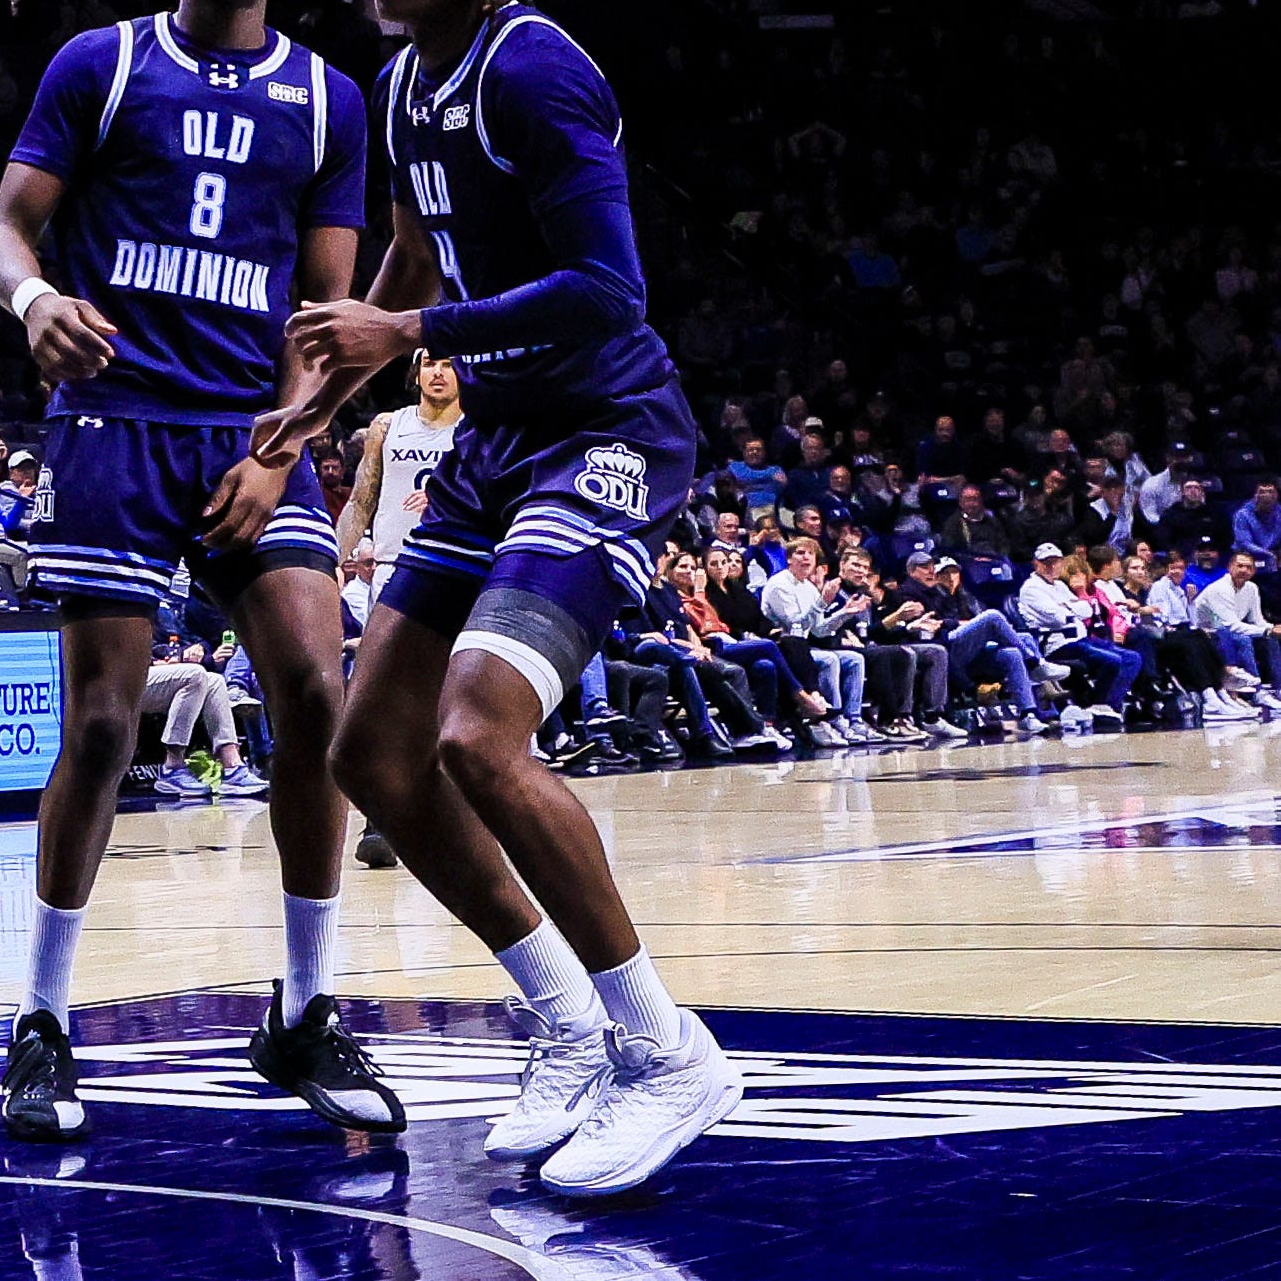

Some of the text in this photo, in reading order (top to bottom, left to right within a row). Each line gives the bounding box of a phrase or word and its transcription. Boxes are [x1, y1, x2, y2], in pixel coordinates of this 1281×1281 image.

[182, 109, 256, 164] OLD
[189, 172, 227, 239] 8
[109, 238, 270, 312] DOMINION
[390, 448, 440, 462] XAVI
[574, 469, 650, 522] ODU
